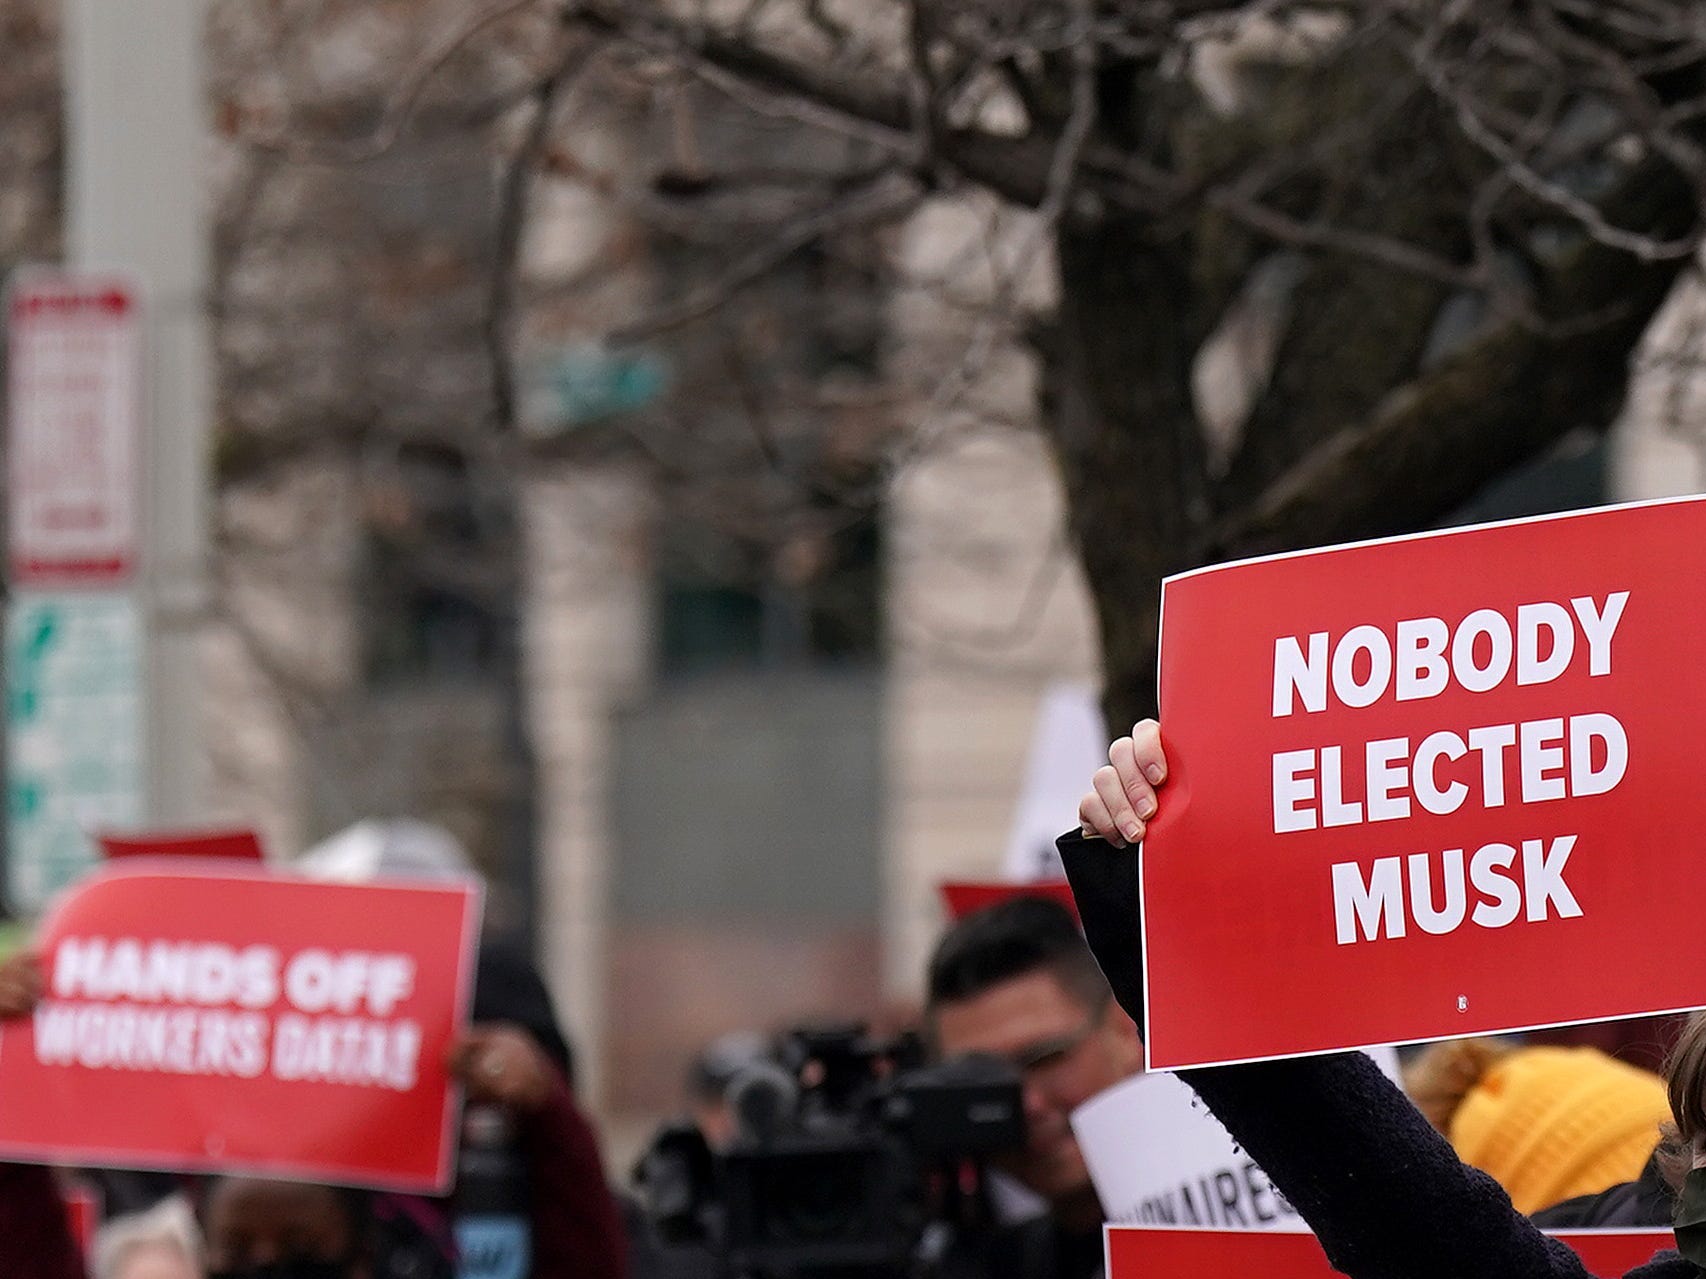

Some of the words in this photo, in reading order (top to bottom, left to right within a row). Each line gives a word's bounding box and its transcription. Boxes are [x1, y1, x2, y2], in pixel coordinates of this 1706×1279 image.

[1271, 590, 1632, 718] NOBODY
[1272, 712, 1630, 834] ELECTED
[1331, 833, 1584, 945] MUSK
[53, 936, 281, 1009] HANDS
[285, 948, 416, 1018] OFF
[33, 1001, 270, 1077] WORKERS
